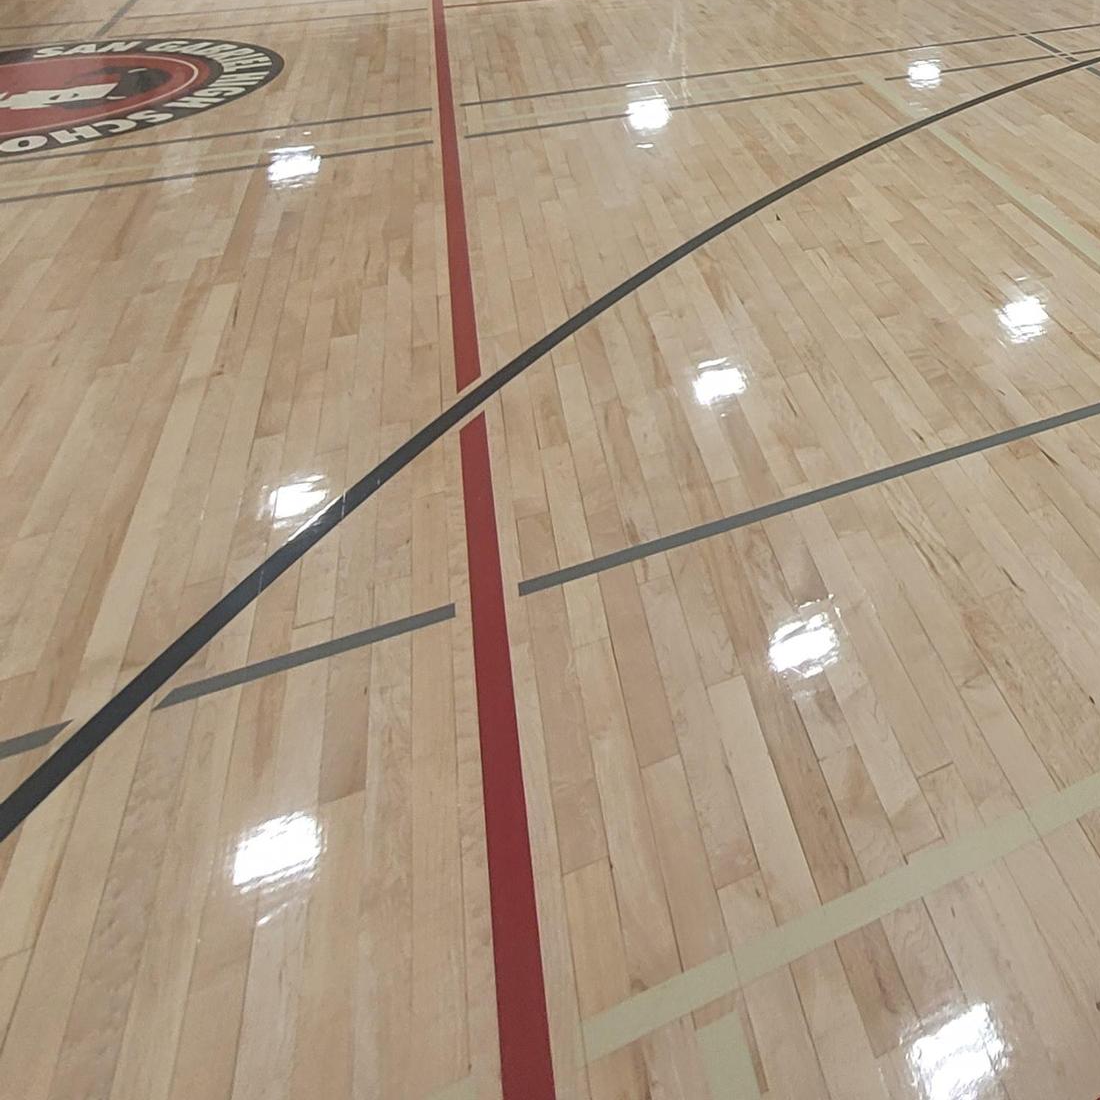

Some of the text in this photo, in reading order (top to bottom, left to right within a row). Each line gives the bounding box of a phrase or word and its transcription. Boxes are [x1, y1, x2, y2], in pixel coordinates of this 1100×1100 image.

[33, 41, 142, 58] SAN
[145, 41, 272, 72] GABRIEL
[163, 71, 270, 108] HIGH
